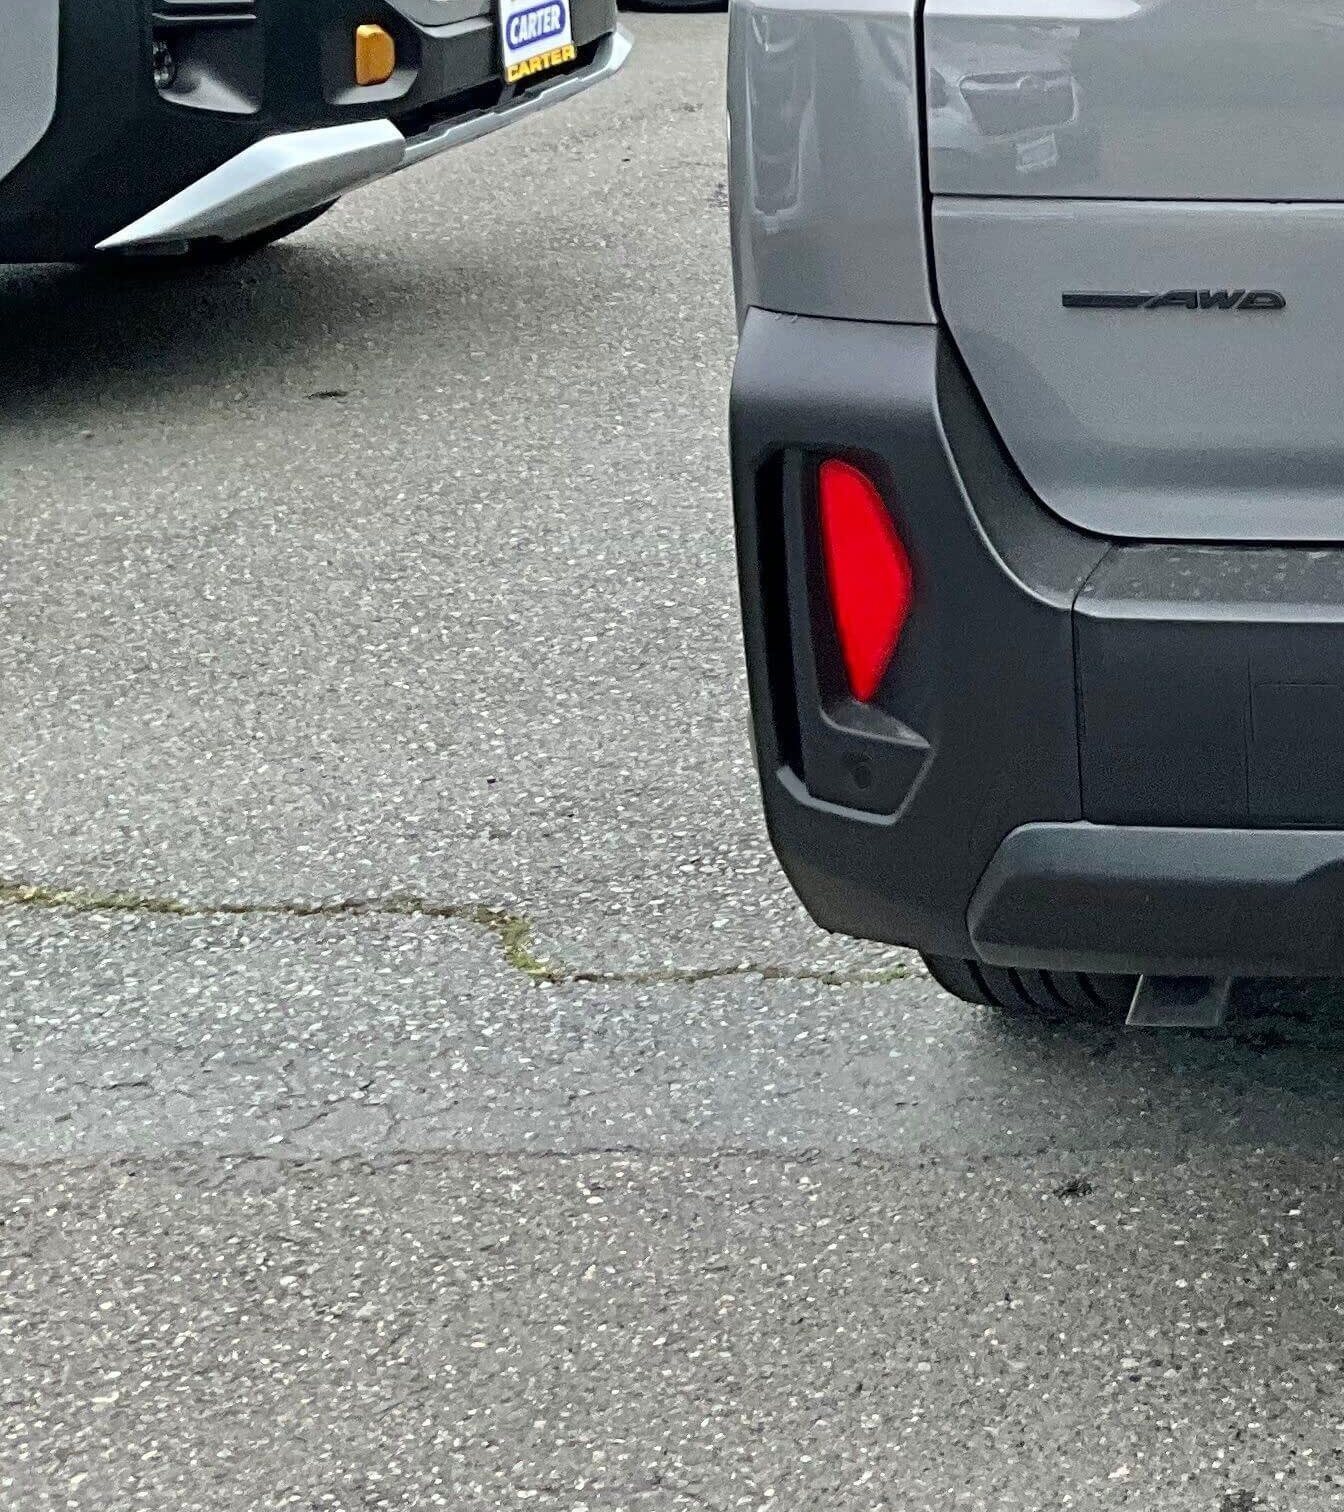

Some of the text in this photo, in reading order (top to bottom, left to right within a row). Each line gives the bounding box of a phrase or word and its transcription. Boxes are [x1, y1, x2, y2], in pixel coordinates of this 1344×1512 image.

[510, 4, 561, 45] CARTER
[507, 45, 575, 82] CARTER
[1143, 289, 1287, 310] AWD
